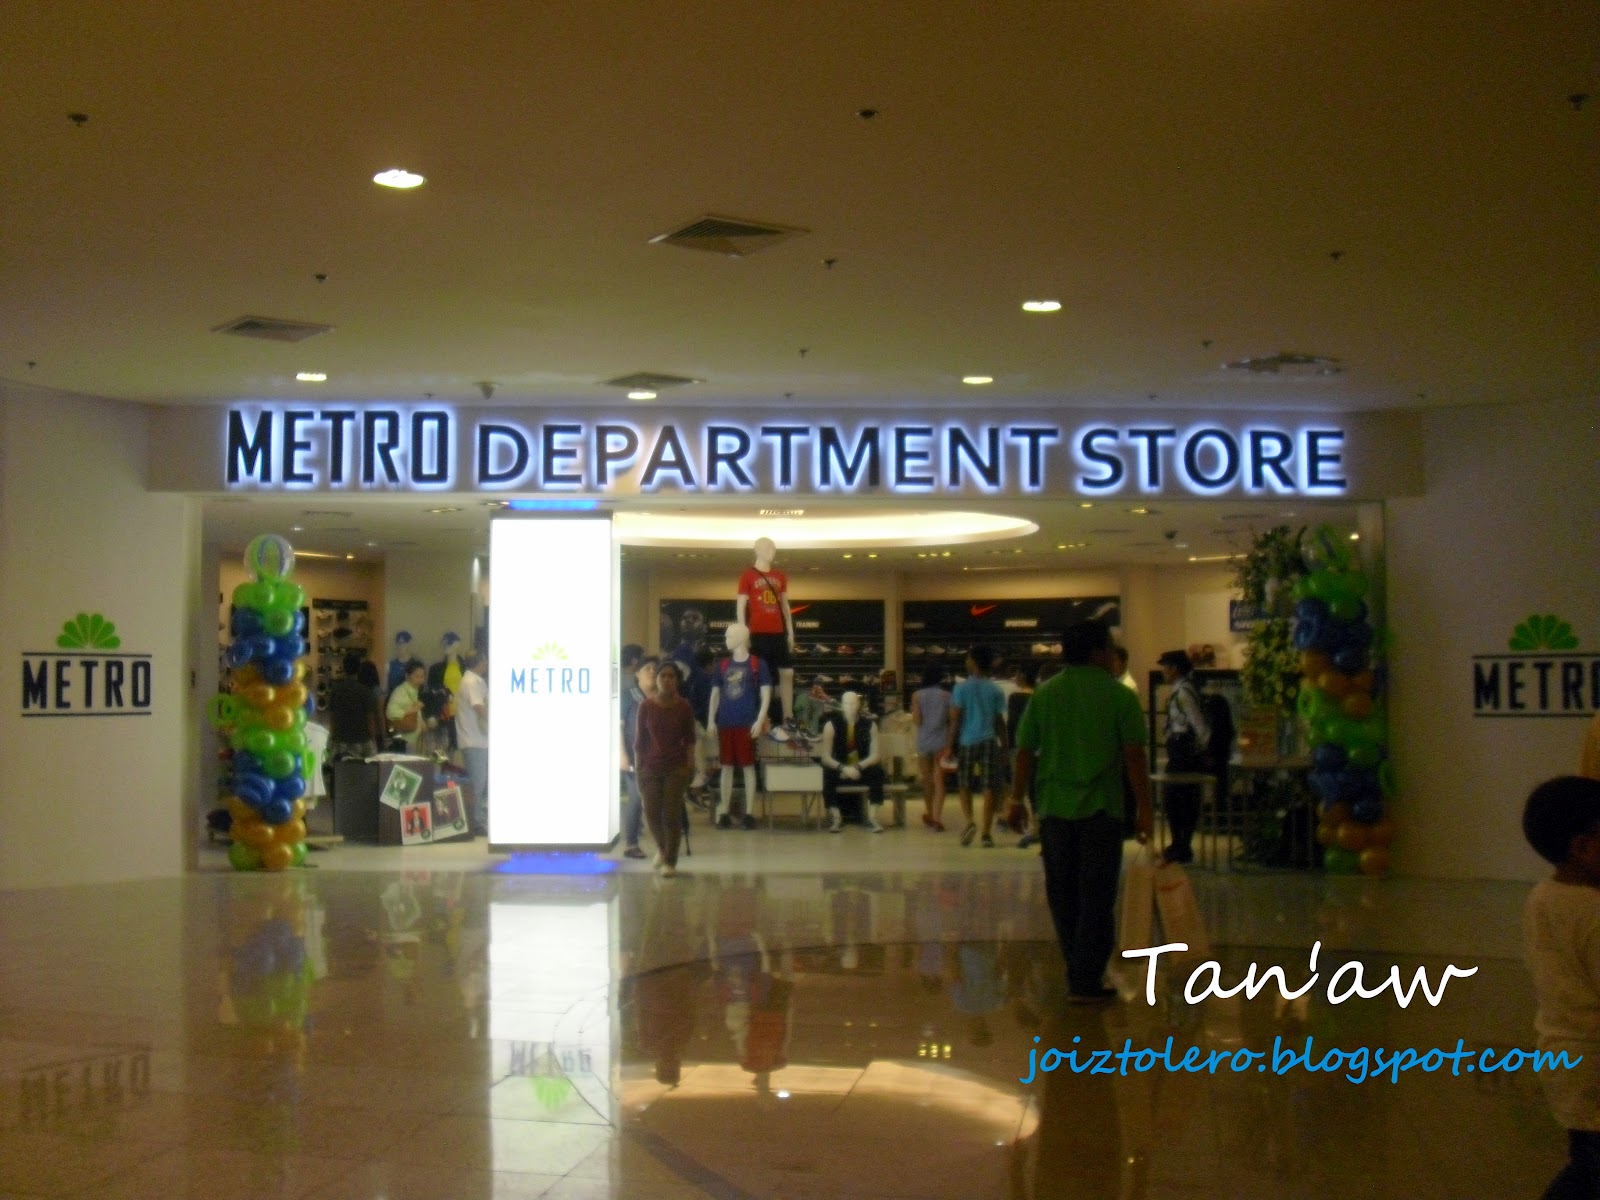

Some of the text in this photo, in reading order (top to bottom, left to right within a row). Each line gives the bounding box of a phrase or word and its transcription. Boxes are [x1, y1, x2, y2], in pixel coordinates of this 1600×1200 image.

[227, 410, 1347, 489] METRO DEPARTMENT STORE
[23, 660, 151, 709] METRO
[511, 667, 590, 694] METRO
